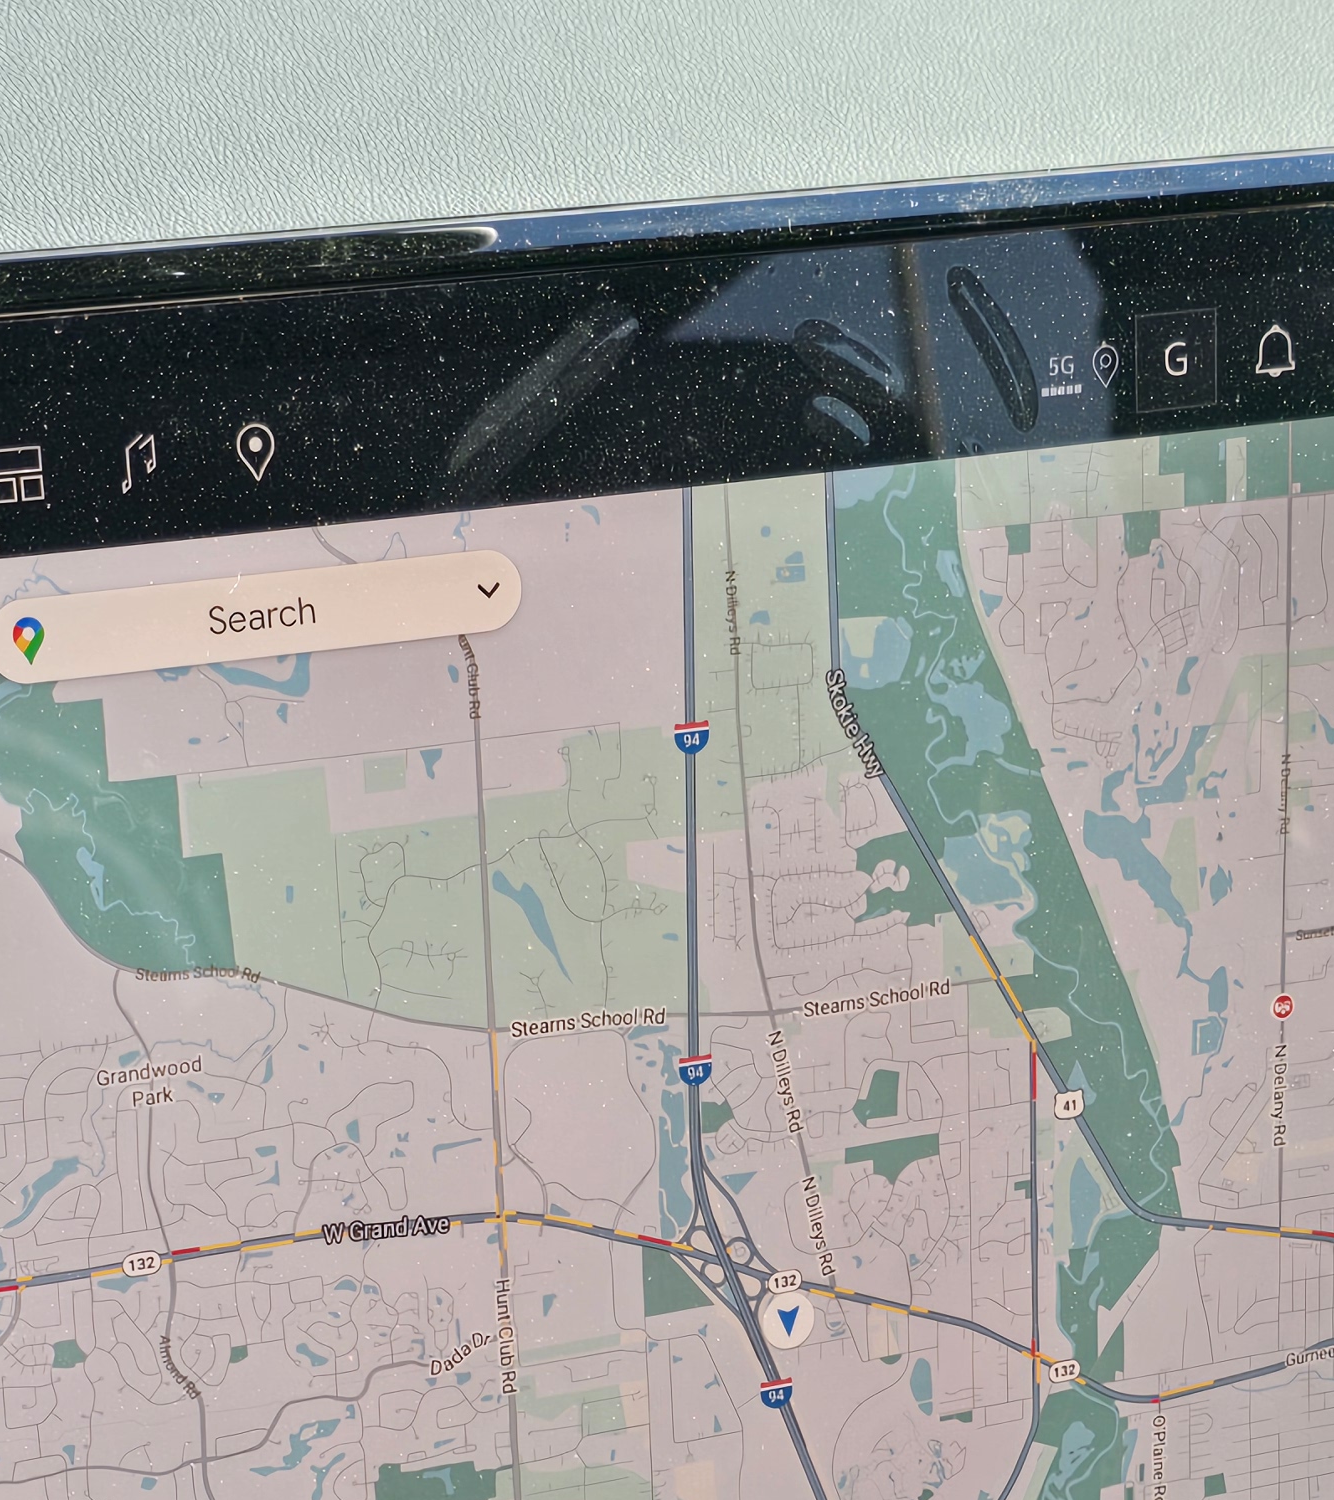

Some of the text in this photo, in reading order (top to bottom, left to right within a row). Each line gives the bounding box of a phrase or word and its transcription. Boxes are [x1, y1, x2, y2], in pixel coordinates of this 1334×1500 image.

[1049, 356, 1074, 376] 5G
[1164, 342, 1188, 376] G
[208, 597, 317, 634] Search
[729, 637, 740, 655] Rd
[467, 663, 480, 697] Club
[469, 701, 481, 719] Rd
[827, 670, 885, 777] Skokie Hwy
[684, 733, 700, 748] 94
[193, 964, 239, 979] School
[241, 967, 260, 984] Rd
[803, 979, 951, 1018] Stearns School Rd
[511, 1008, 666, 1038] Stearns School Rd
[96, 1055, 202, 1086] Grandwood
[688, 1065, 703, 1080] 94
[768, 1030, 803, 1133] N Dilleys Rd
[132, 1087, 174, 1107] Park
[1062, 1099, 1077, 1112] 41
[1270, 1045, 1287, 1147] N Delany Rd
[322, 1216, 450, 1244] W Grand Ave
[802, 1176, 836, 1276] N Dilleys Rd
[129, 1257, 156, 1271] 132
[774, 1274, 797, 1288] 132
[496, 1279, 517, 1394] Hunt Club Rd
[159, 1335, 201, 1399] Almond Rd
[431, 1332, 491, 1376] Dada Dr
[1054, 1363, 1075, 1378] 132
[769, 1389, 784, 1403] 94
[1153, 1415, 1165, 1480] O'Plaine
